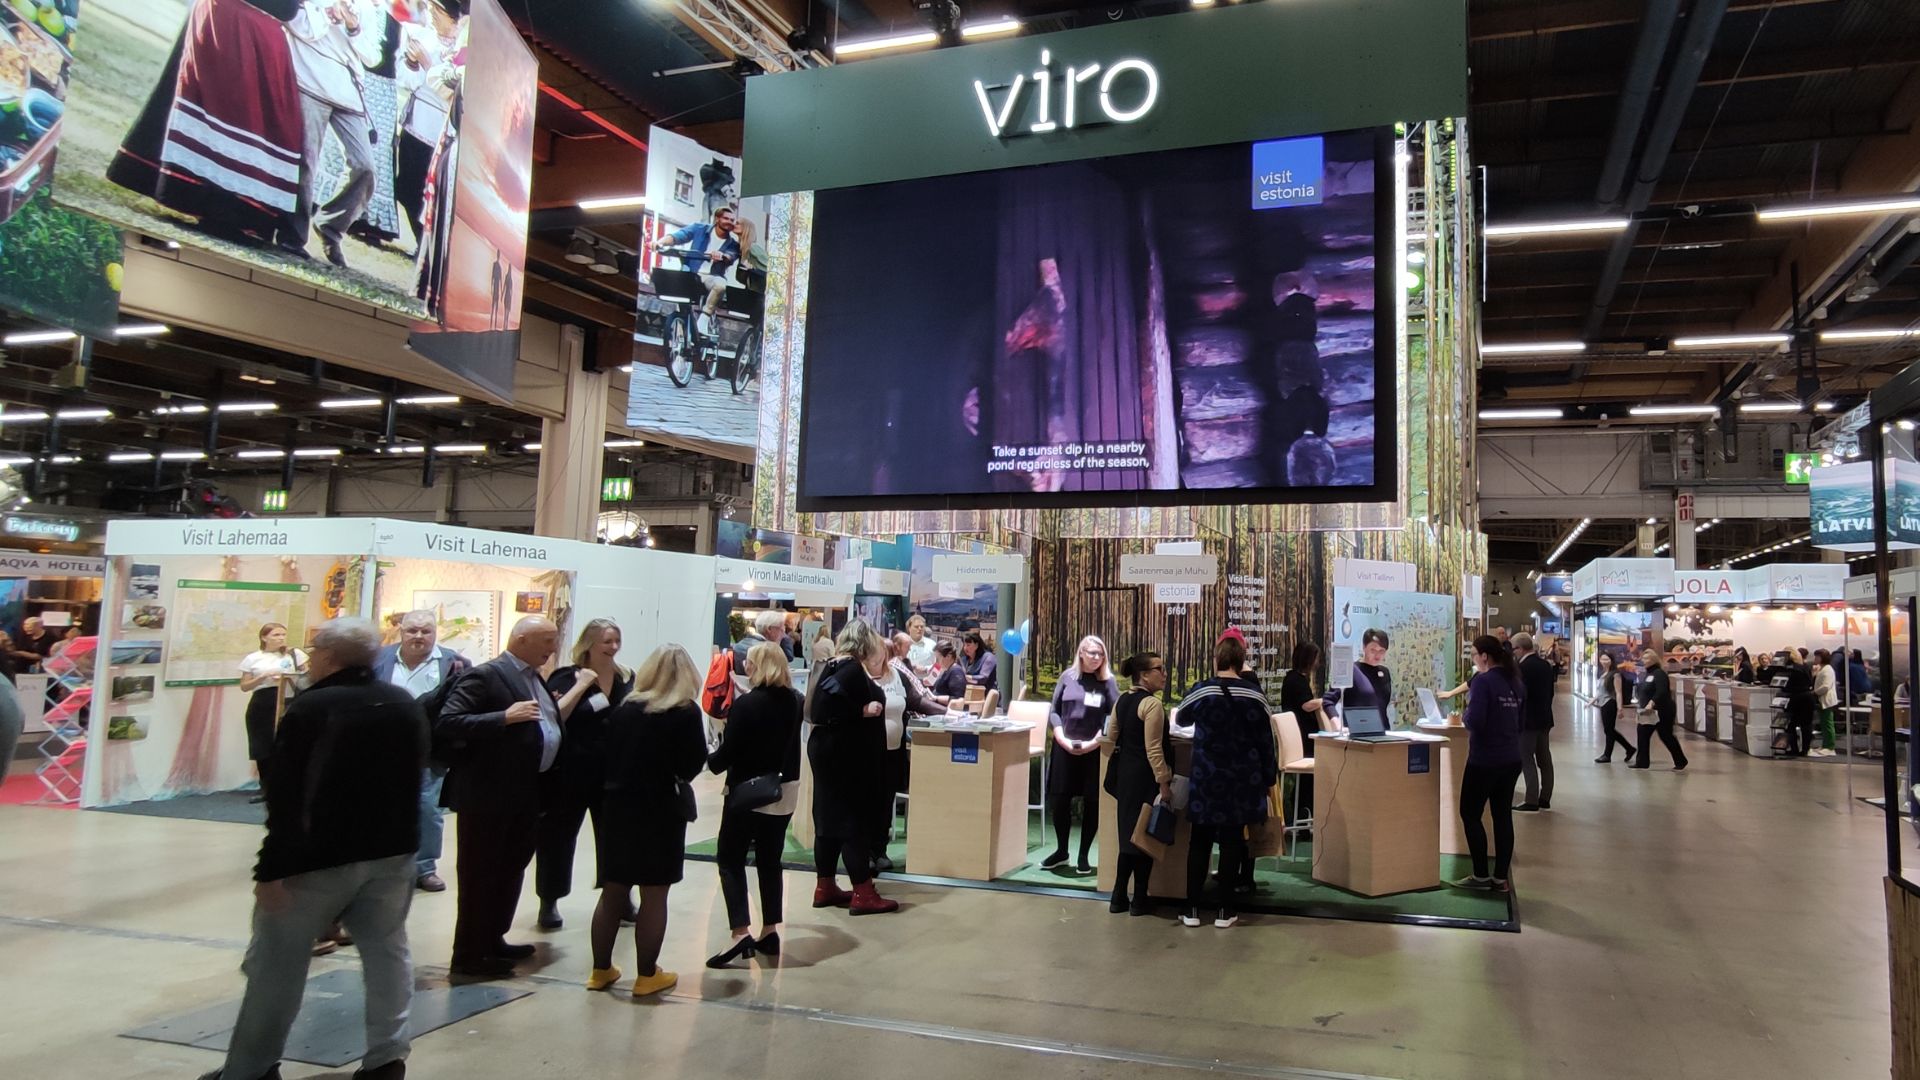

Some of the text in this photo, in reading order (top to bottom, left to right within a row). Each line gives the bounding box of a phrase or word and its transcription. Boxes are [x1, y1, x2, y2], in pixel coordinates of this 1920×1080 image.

[973, 49, 1159, 137] viro
[1259, 169, 1293, 186] visit
[1259, 184, 1316, 201] estonia
[992, 441, 1146, 457] Take a sunset dip in a nearby
[987, 456, 1150, 473] pond regardless of the season,
[1818, 517, 1875, 534] LATVI
[182, 528, 289, 546] Visit Lahemaa
[425, 533, 547, 561] Visit Lahemaa
[48, 561, 93, 572] HOTEL
[1175, 568, 1183, 577] ja
[1184, 567, 1209, 576] Muhu
[748, 567, 771, 582] Viron
[773, 571, 834, 587] Maatilamatkailu
[1228, 574, 1243, 584] Visit
[1357, 571, 1373, 581] Visit
[1159, 585, 1197, 597] estonia
[1228, 586, 1243, 595] Visit
[1228, 598, 1243, 607] Visit
[1228, 610, 1243, 619] Visit
